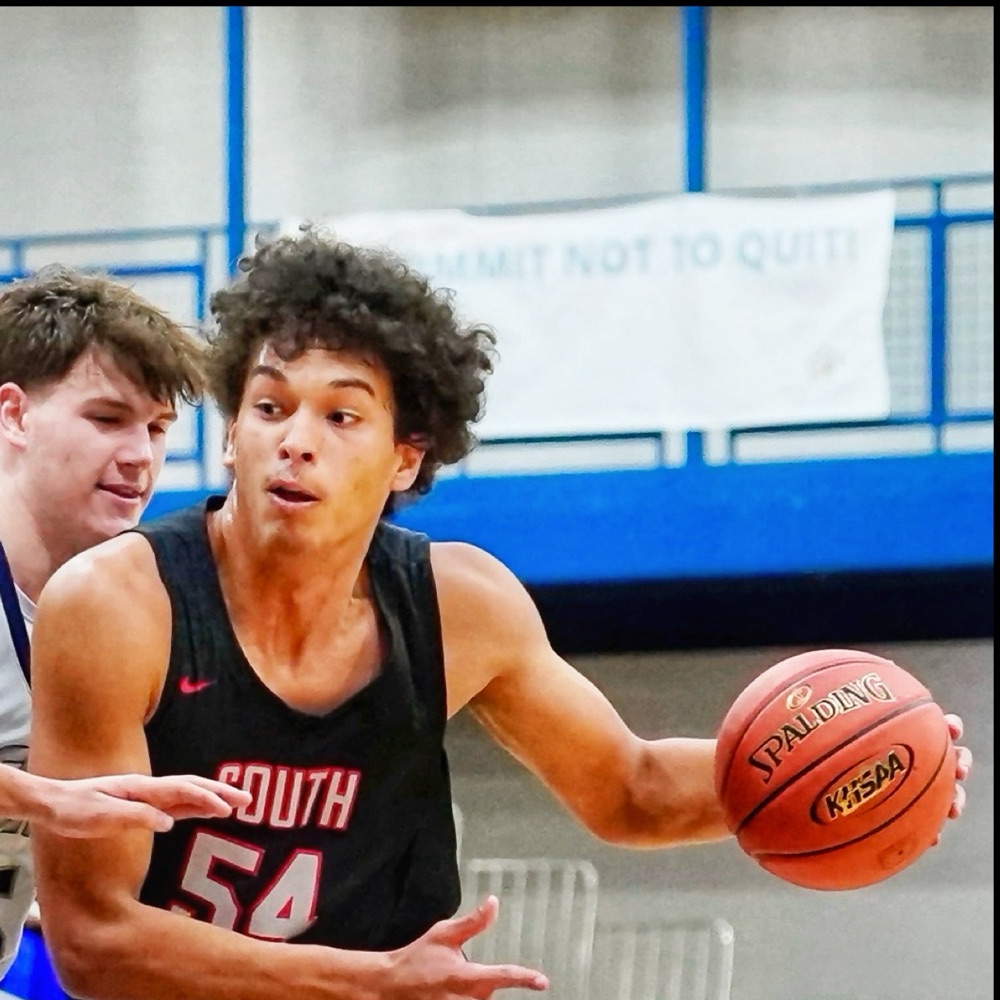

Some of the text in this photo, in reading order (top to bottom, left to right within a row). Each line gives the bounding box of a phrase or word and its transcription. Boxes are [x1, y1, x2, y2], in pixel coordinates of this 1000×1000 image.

[562, 231, 651, 276] NOT
[670, 229, 724, 275] TO
[748, 671, 897, 785] SPALDING
[171, 827, 323, 943] 54
